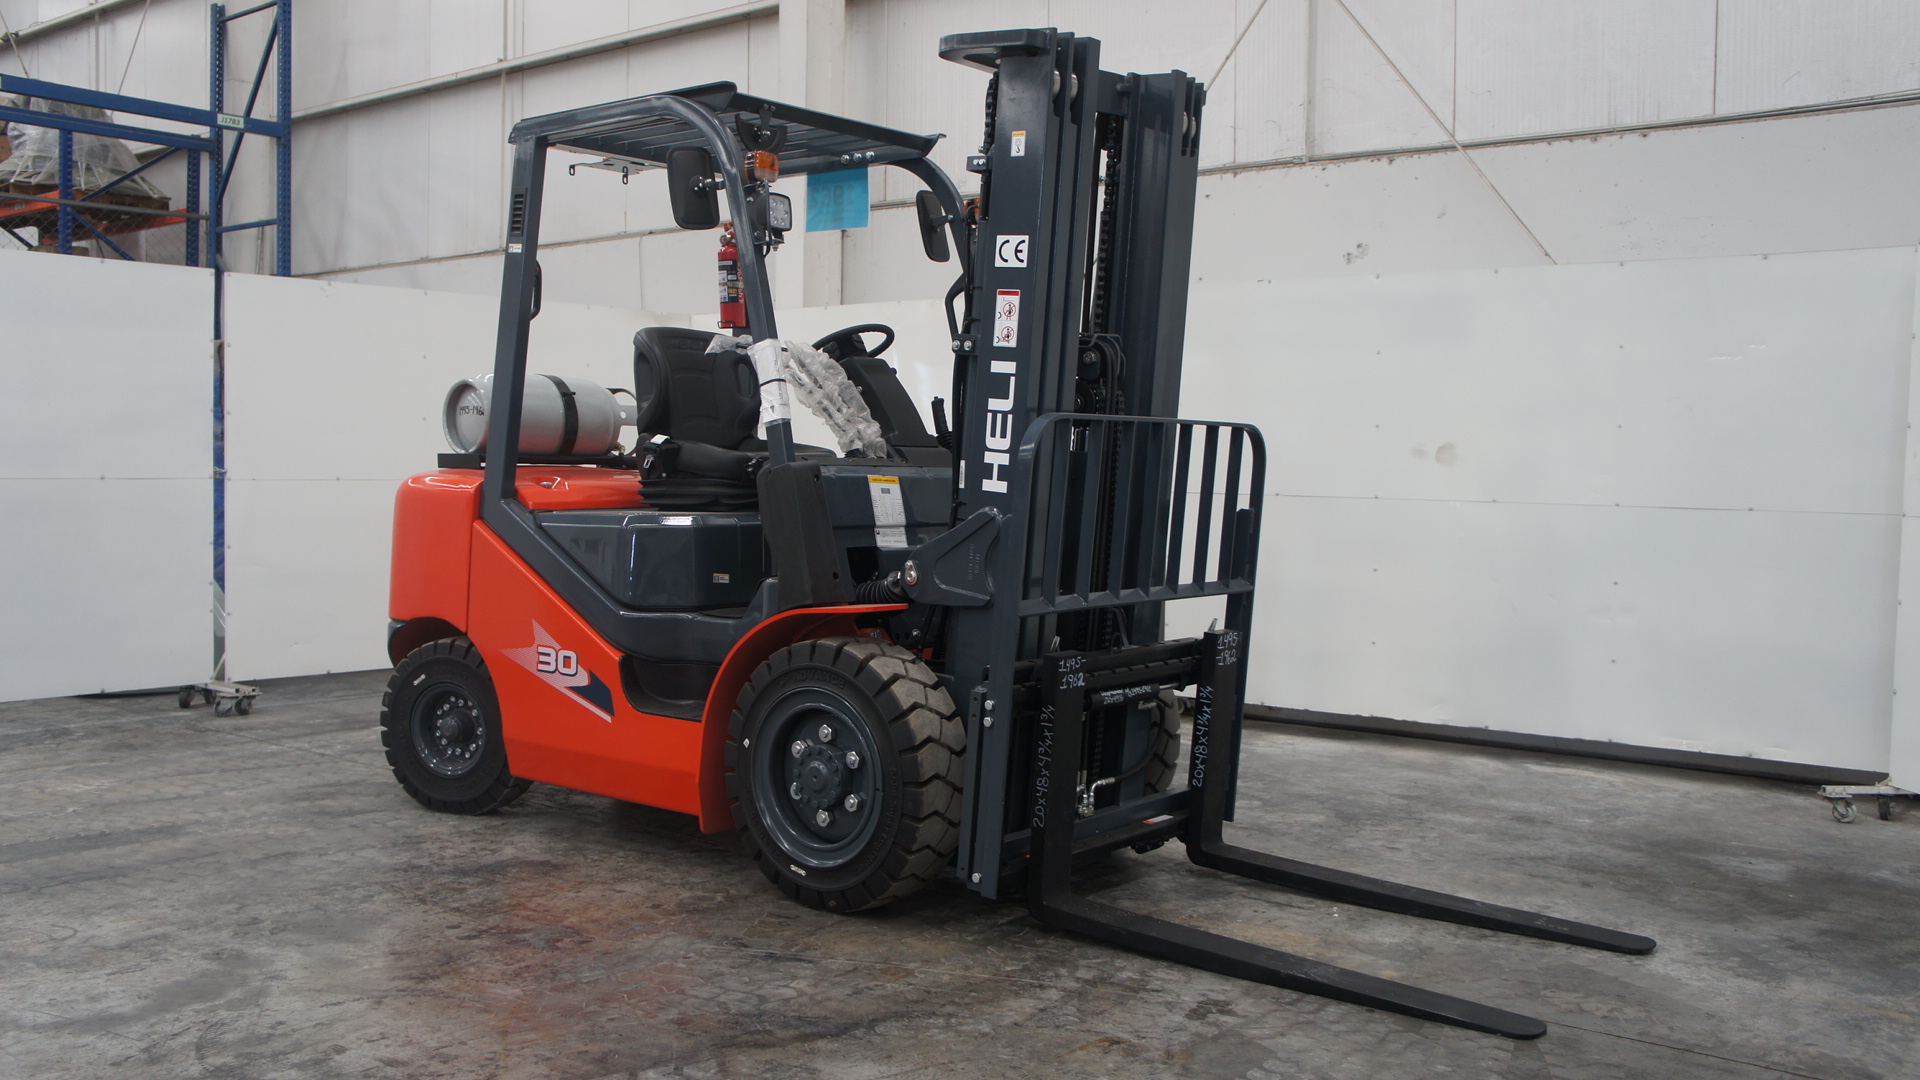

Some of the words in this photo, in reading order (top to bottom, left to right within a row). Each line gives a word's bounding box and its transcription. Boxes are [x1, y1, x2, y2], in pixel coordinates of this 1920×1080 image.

[998, 239, 1026, 263] CE
[981, 360, 1017, 494] HELI
[537, 645, 579, 677] 30
[792, 669, 845, 690] ADVANCE
